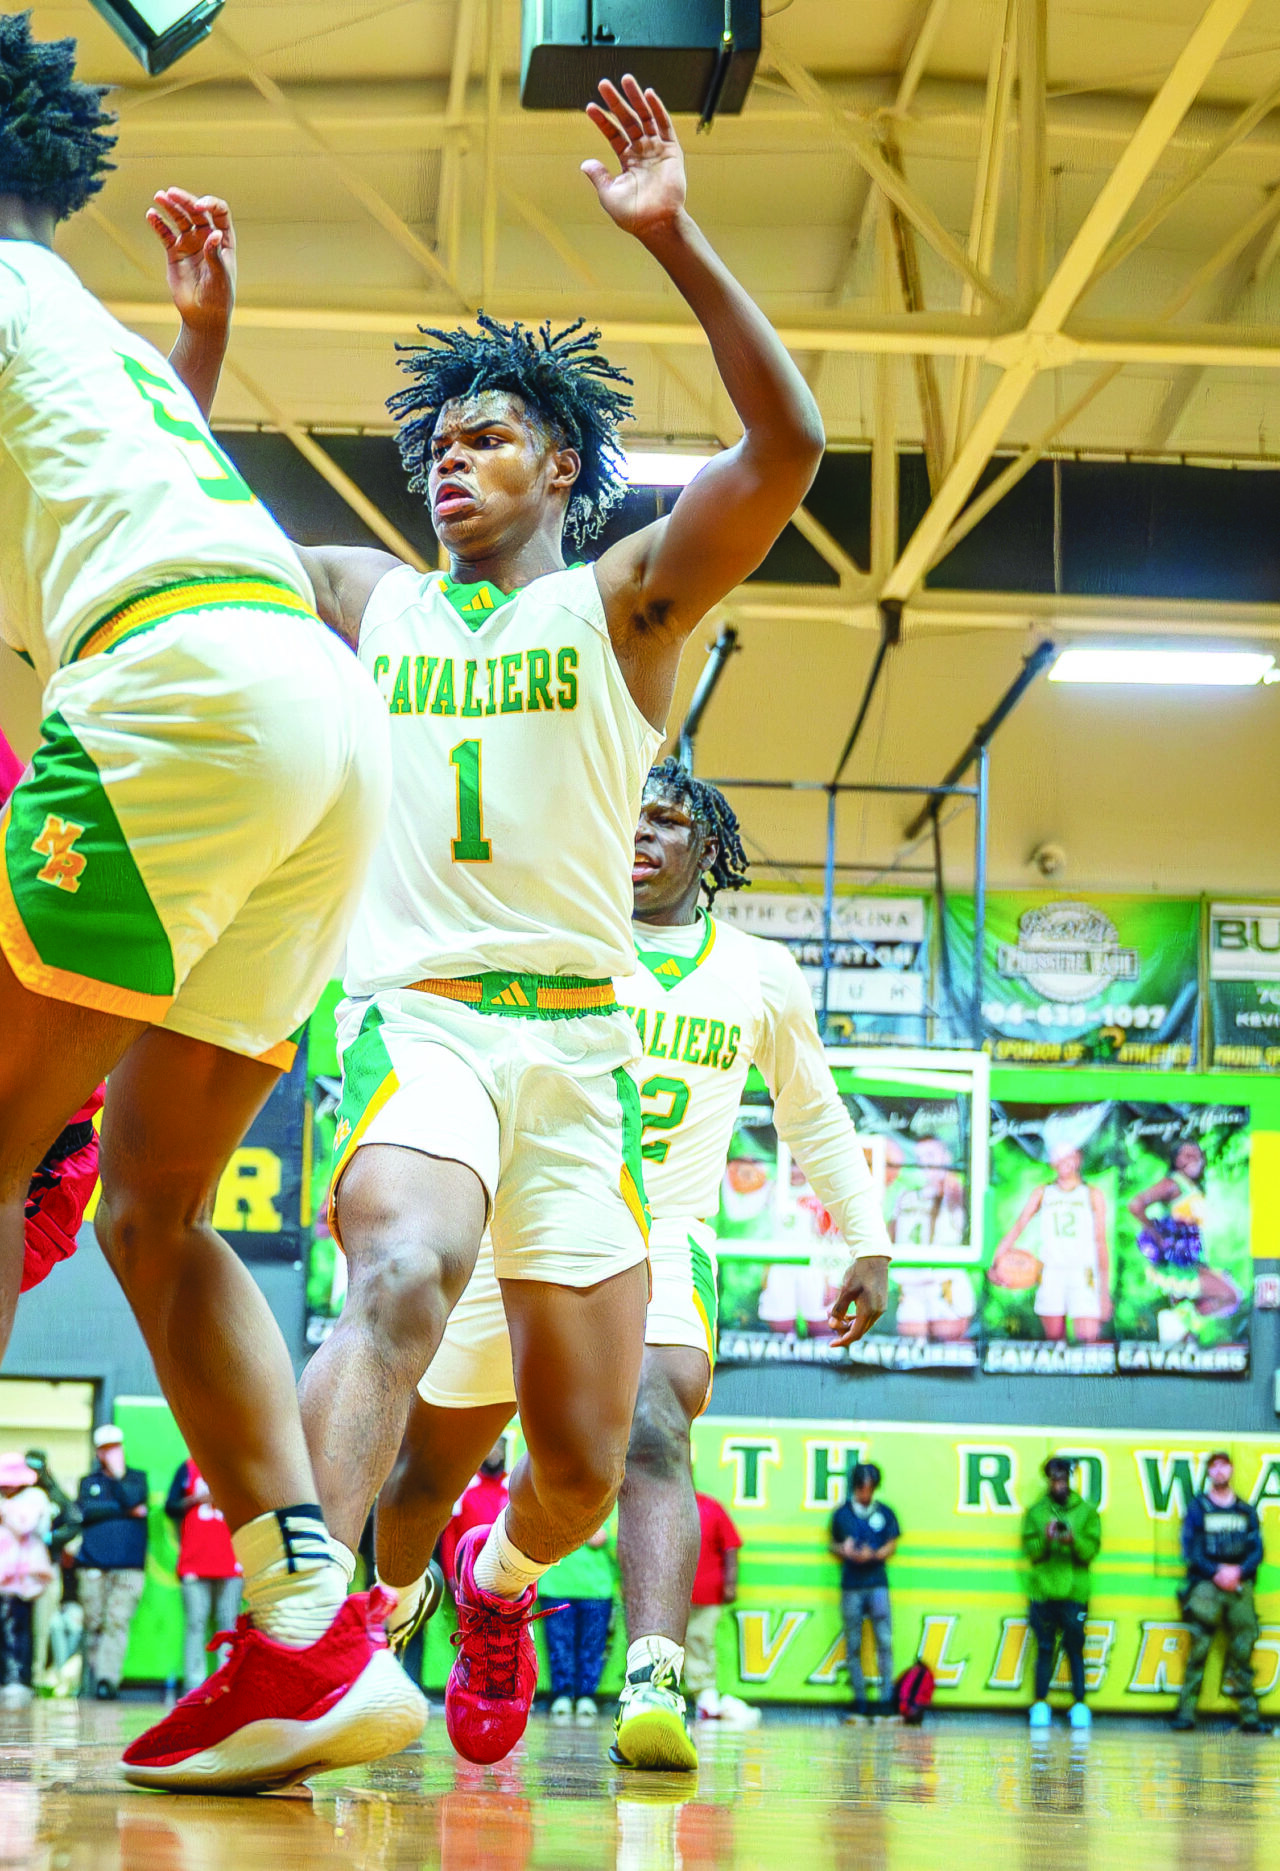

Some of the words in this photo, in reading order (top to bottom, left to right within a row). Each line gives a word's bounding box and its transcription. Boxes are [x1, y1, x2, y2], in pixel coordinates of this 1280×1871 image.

[373, 646, 580, 718] CAVALIERS
[449, 738, 493, 864] 1
[618, 1005, 741, 1071] ALIERS
[212, 1146, 282, 1233] R
[718, 1436, 868, 1510] TH
